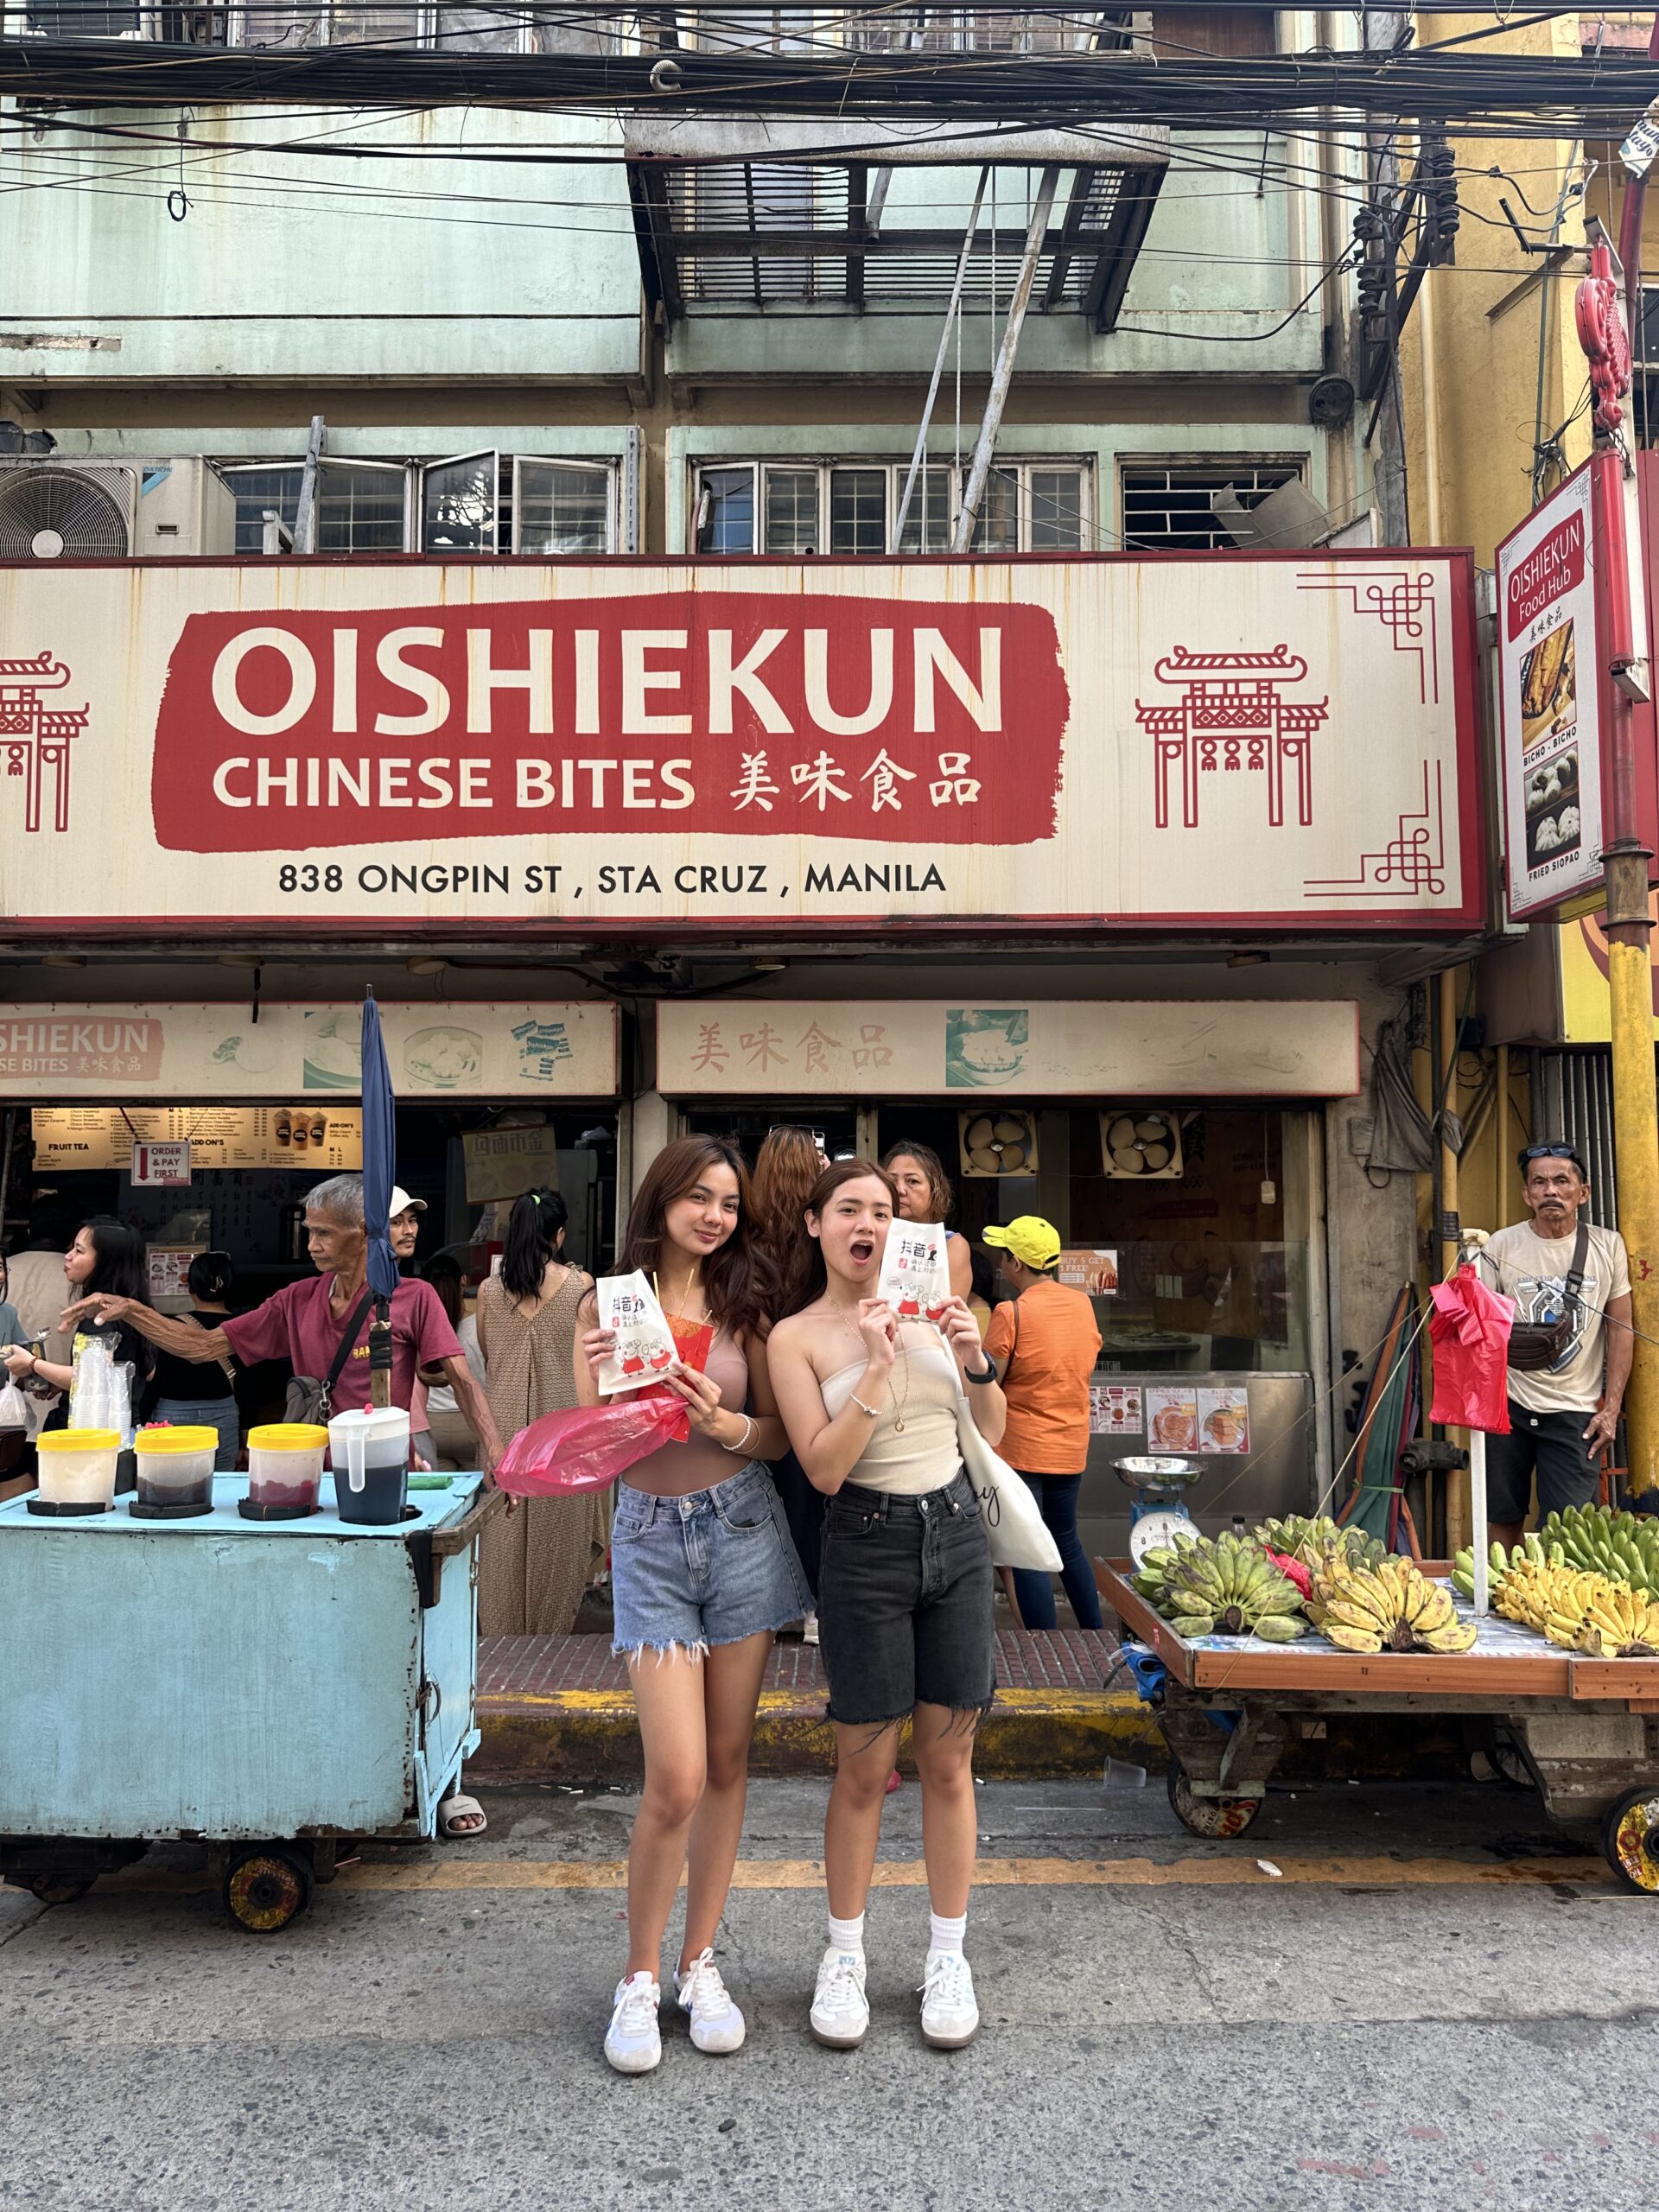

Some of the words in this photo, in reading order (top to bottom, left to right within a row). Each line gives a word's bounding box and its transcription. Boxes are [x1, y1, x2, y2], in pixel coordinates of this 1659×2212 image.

[1511, 519, 1580, 602] OISHIEKUN
[1520, 583, 1545, 622] Food
[1548, 566, 1571, 598] Hub
[1529, 606, 1562, 643] 美味食品
[212, 626, 1002, 735] OISHIEKUN
[1523, 746, 1545, 766] BICHO
[1553, 726, 1577, 748] BICHO
[213, 757, 493, 808] CHINESE
[516, 759, 696, 810] BITES
[729, 748, 982, 812] 美味食品
[279, 864, 343, 893] 838
[358, 864, 510, 893] ONGPIN
[598, 865, 662, 893] STA
[674, 865, 767, 893] CRUZ
[804, 863, 947, 893] MANILA
[1529, 865, 1549, 882] FRIED
[1552, 851, 1580, 872] SIOPAO
[22, 1058, 68, 1072] BITES
[76, 1056, 142, 1073] 美味食品
[690, 1020, 893, 1074] 美味食品
[155, 1169, 178, 1179] FIRST
[900, 1238, 926, 1257] 抖音
[613, 1296, 632, 1313] 抖音
